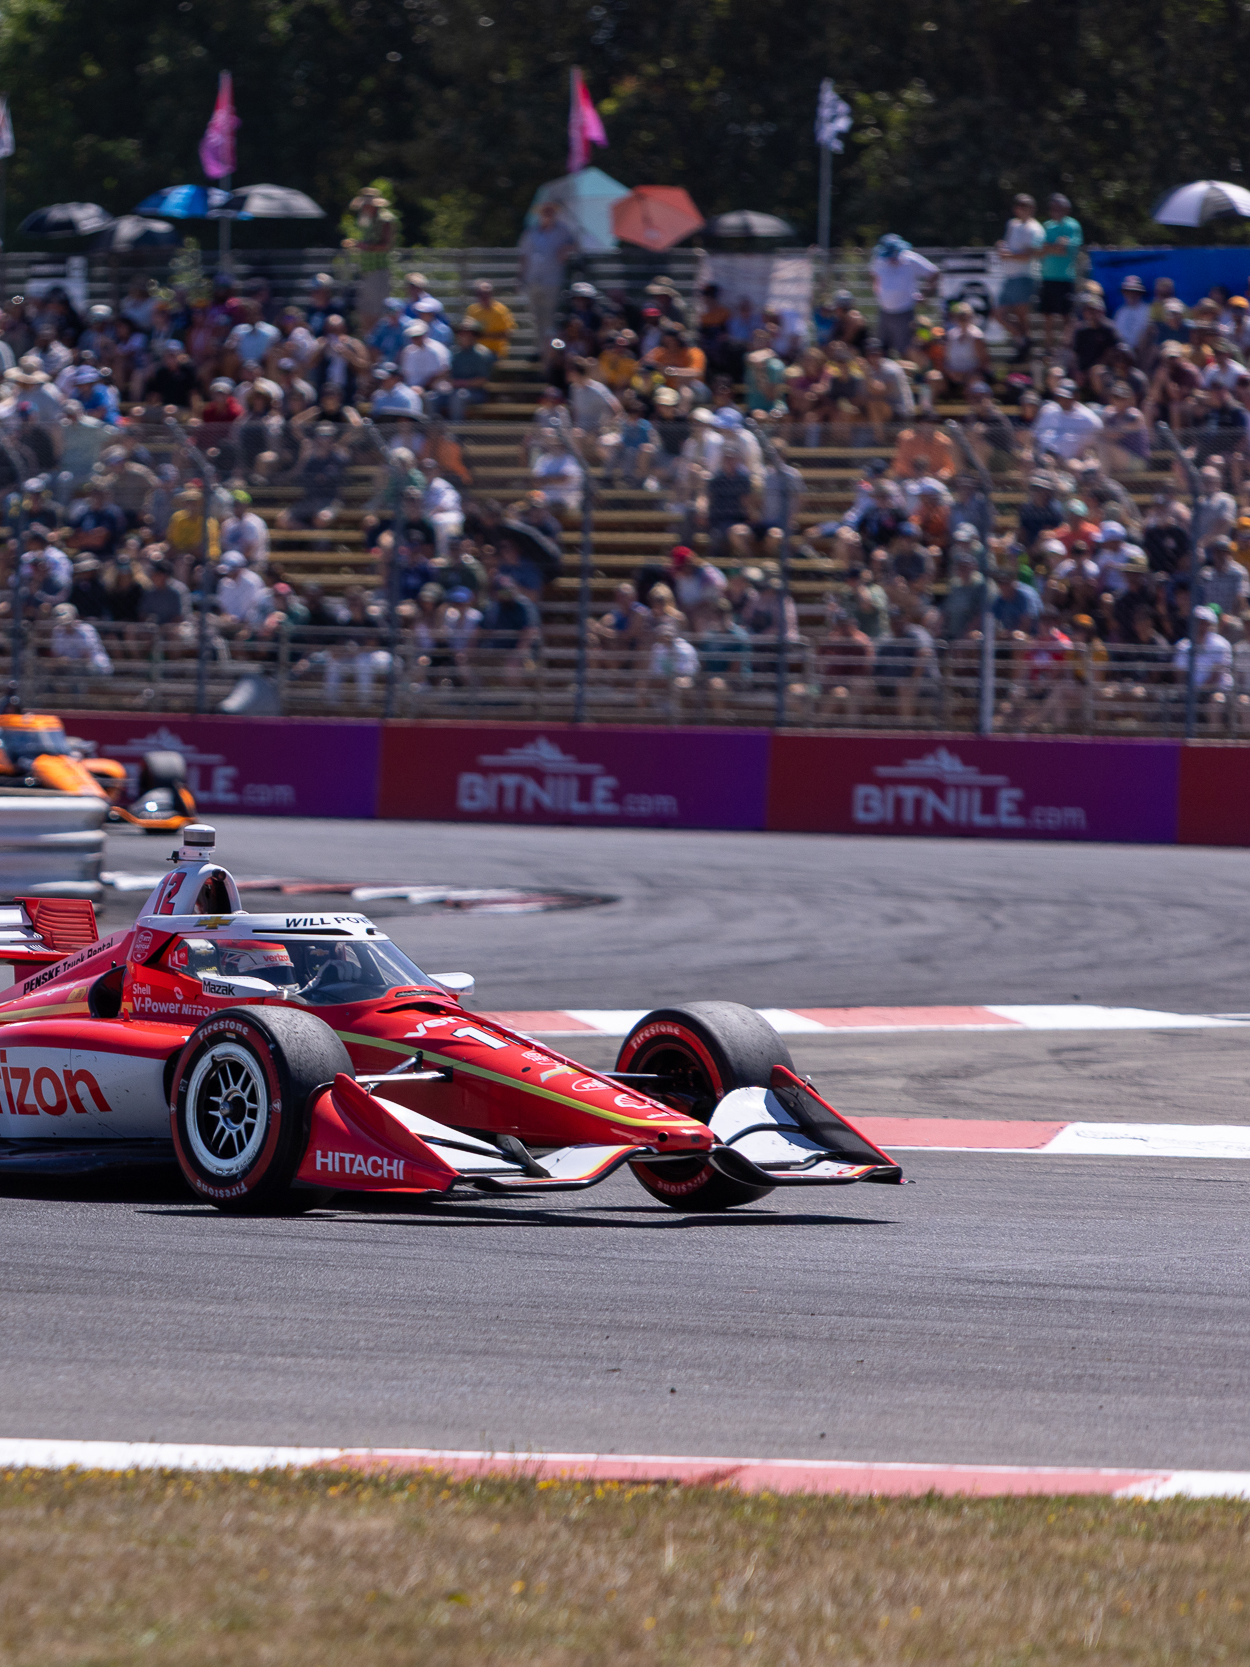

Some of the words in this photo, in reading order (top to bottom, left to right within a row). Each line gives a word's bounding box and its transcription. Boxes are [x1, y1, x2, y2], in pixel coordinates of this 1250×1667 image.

[153, 872, 187, 915] 12
[286, 917, 331, 928] WILL
[334, 917, 372, 925] POW
[263, 953, 290, 962] verizo
[23, 965, 61, 996] PENSKE
[132, 983, 151, 995] Shell
[203, 980, 236, 996] Mazak
[133, 997, 180, 1014] V-Power
[198, 1019, 249, 1041] Firestone
[630, 1023, 680, 1050] Firestone
[316, 1149, 405, 1180] HITACHI
[196, 1178, 248, 1198] Firestone
